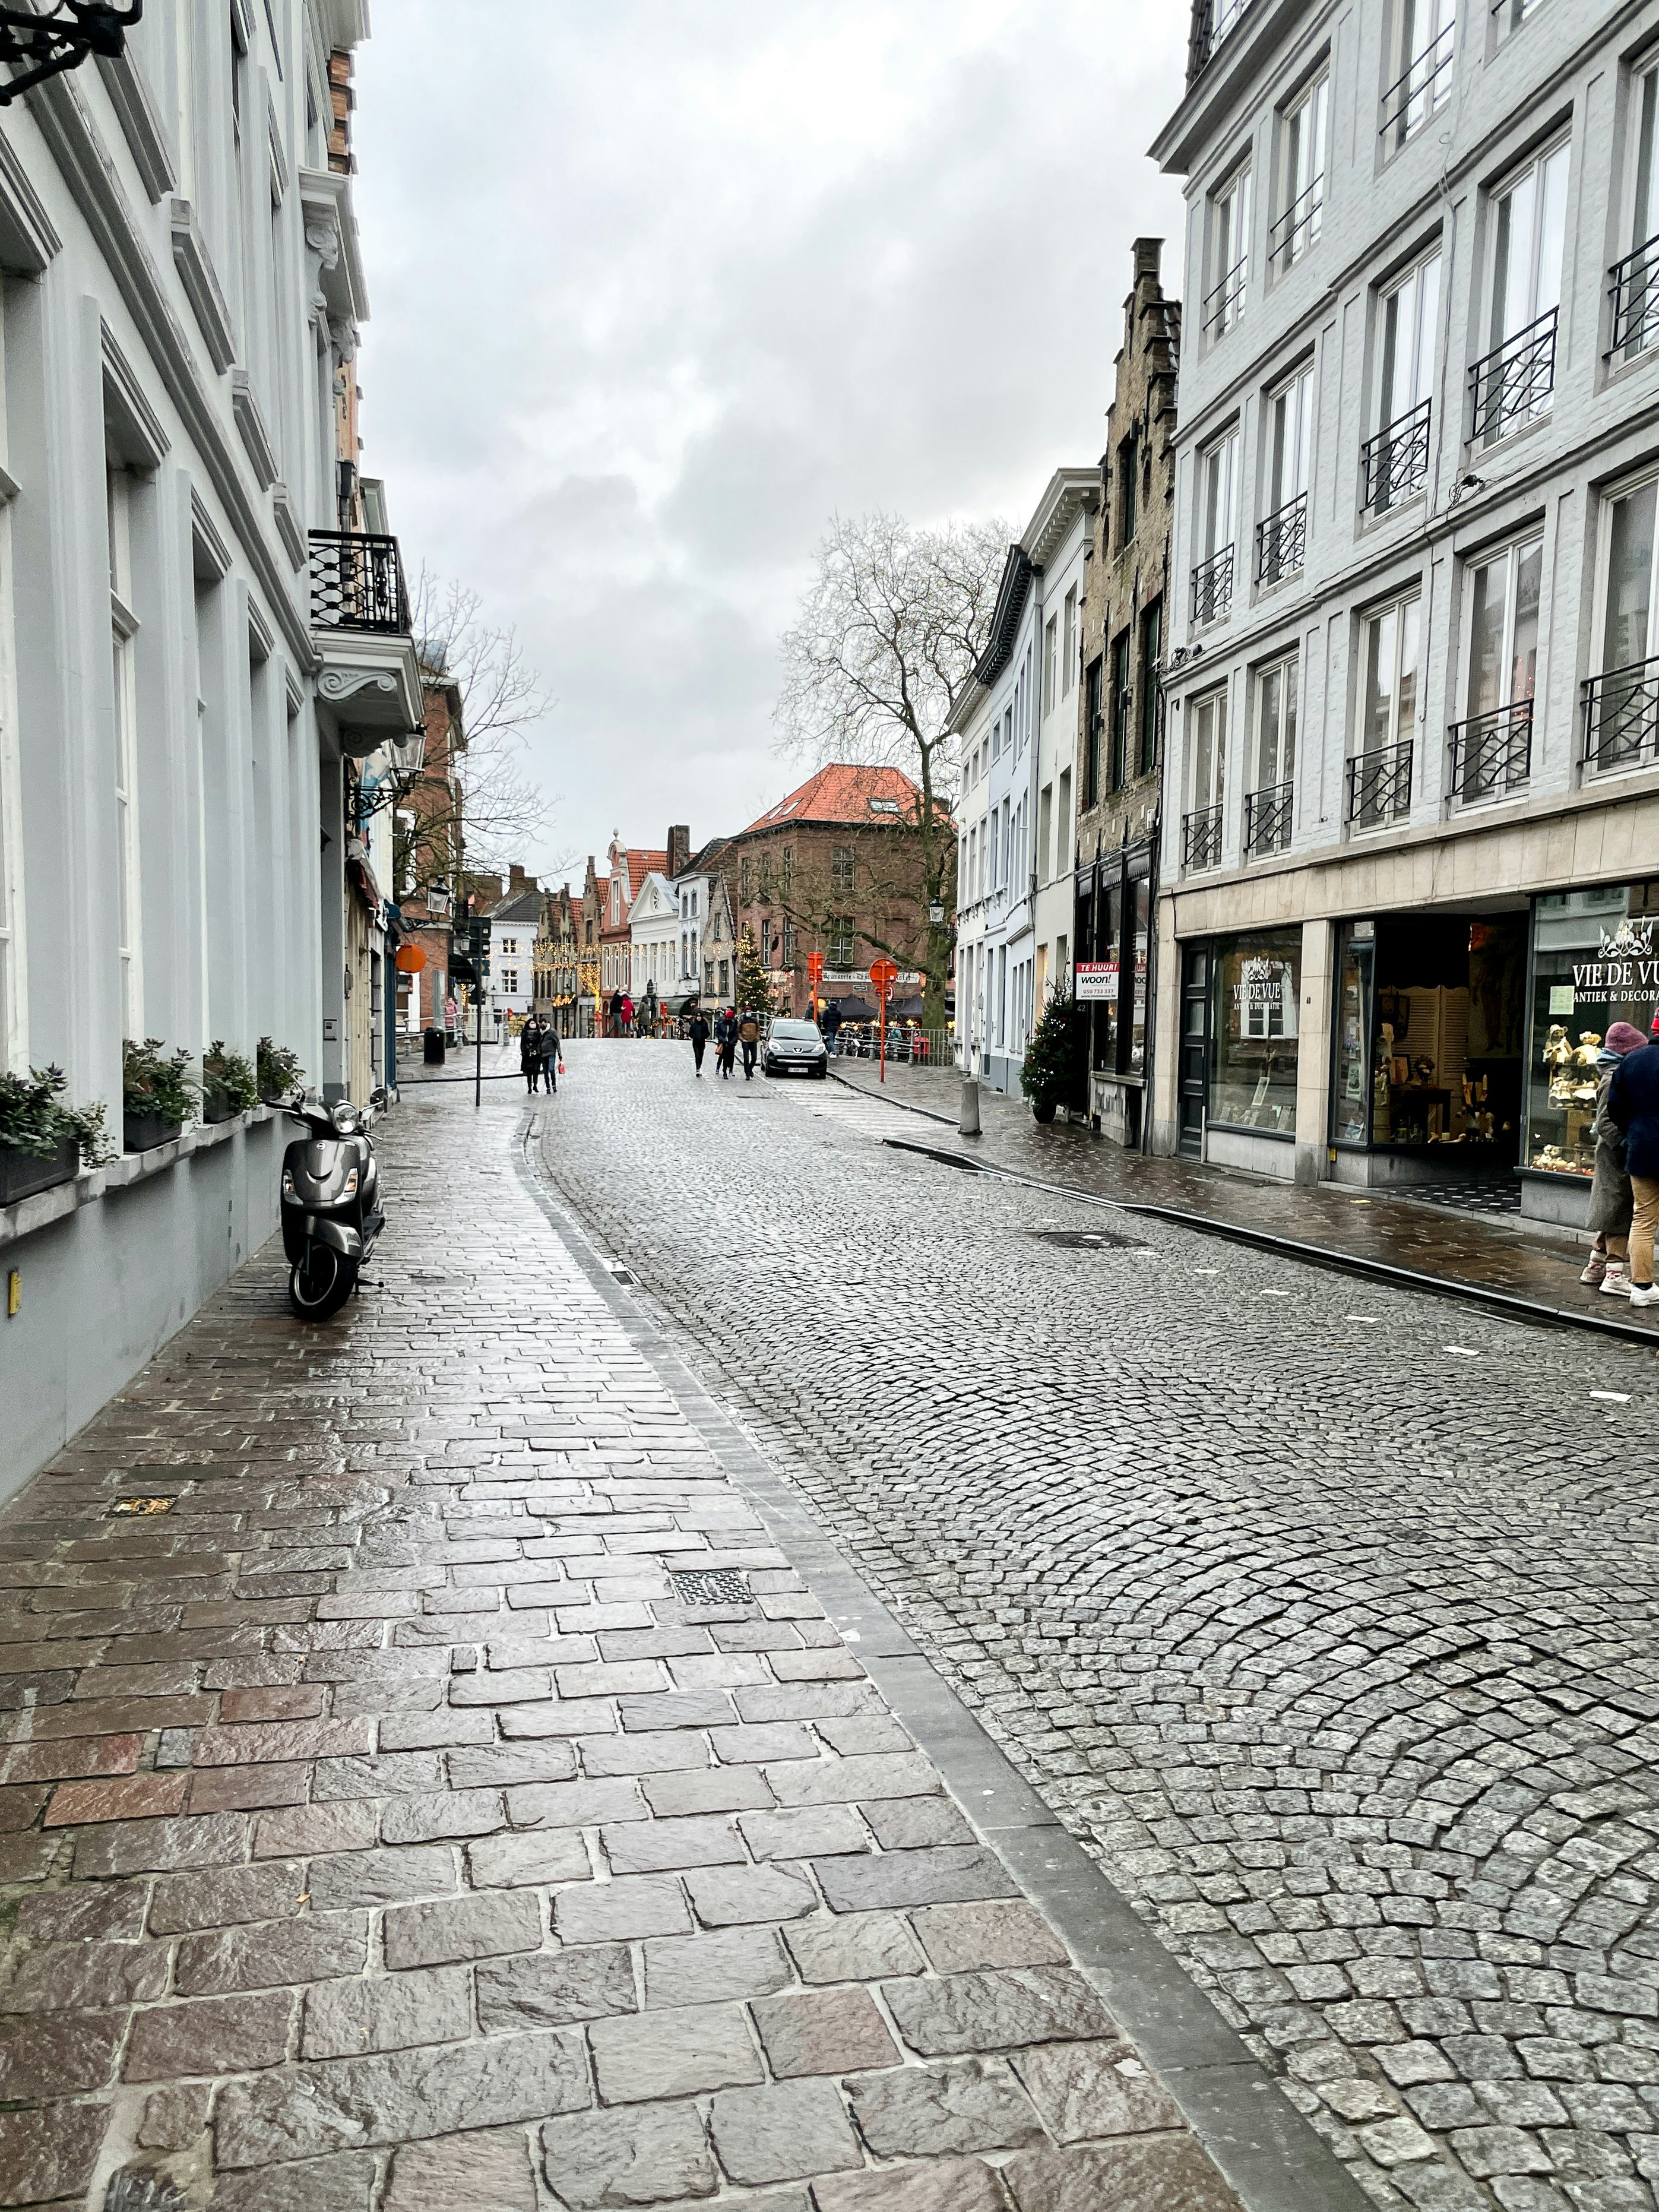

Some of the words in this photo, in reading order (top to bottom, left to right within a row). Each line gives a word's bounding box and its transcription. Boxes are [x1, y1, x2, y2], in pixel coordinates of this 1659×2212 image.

[1081, 974, 1111, 984] woon!
[1572, 963, 1603, 987] VIE
[1606, 962, 1633, 986] DE
[1233, 984, 1247, 999] VIE
[1249, 983, 1260, 999] DE
[1262, 982, 1281, 998] VUE
[1574, 991, 1607, 1002] ANTIEK
[1610, 991, 1618, 1002] &
